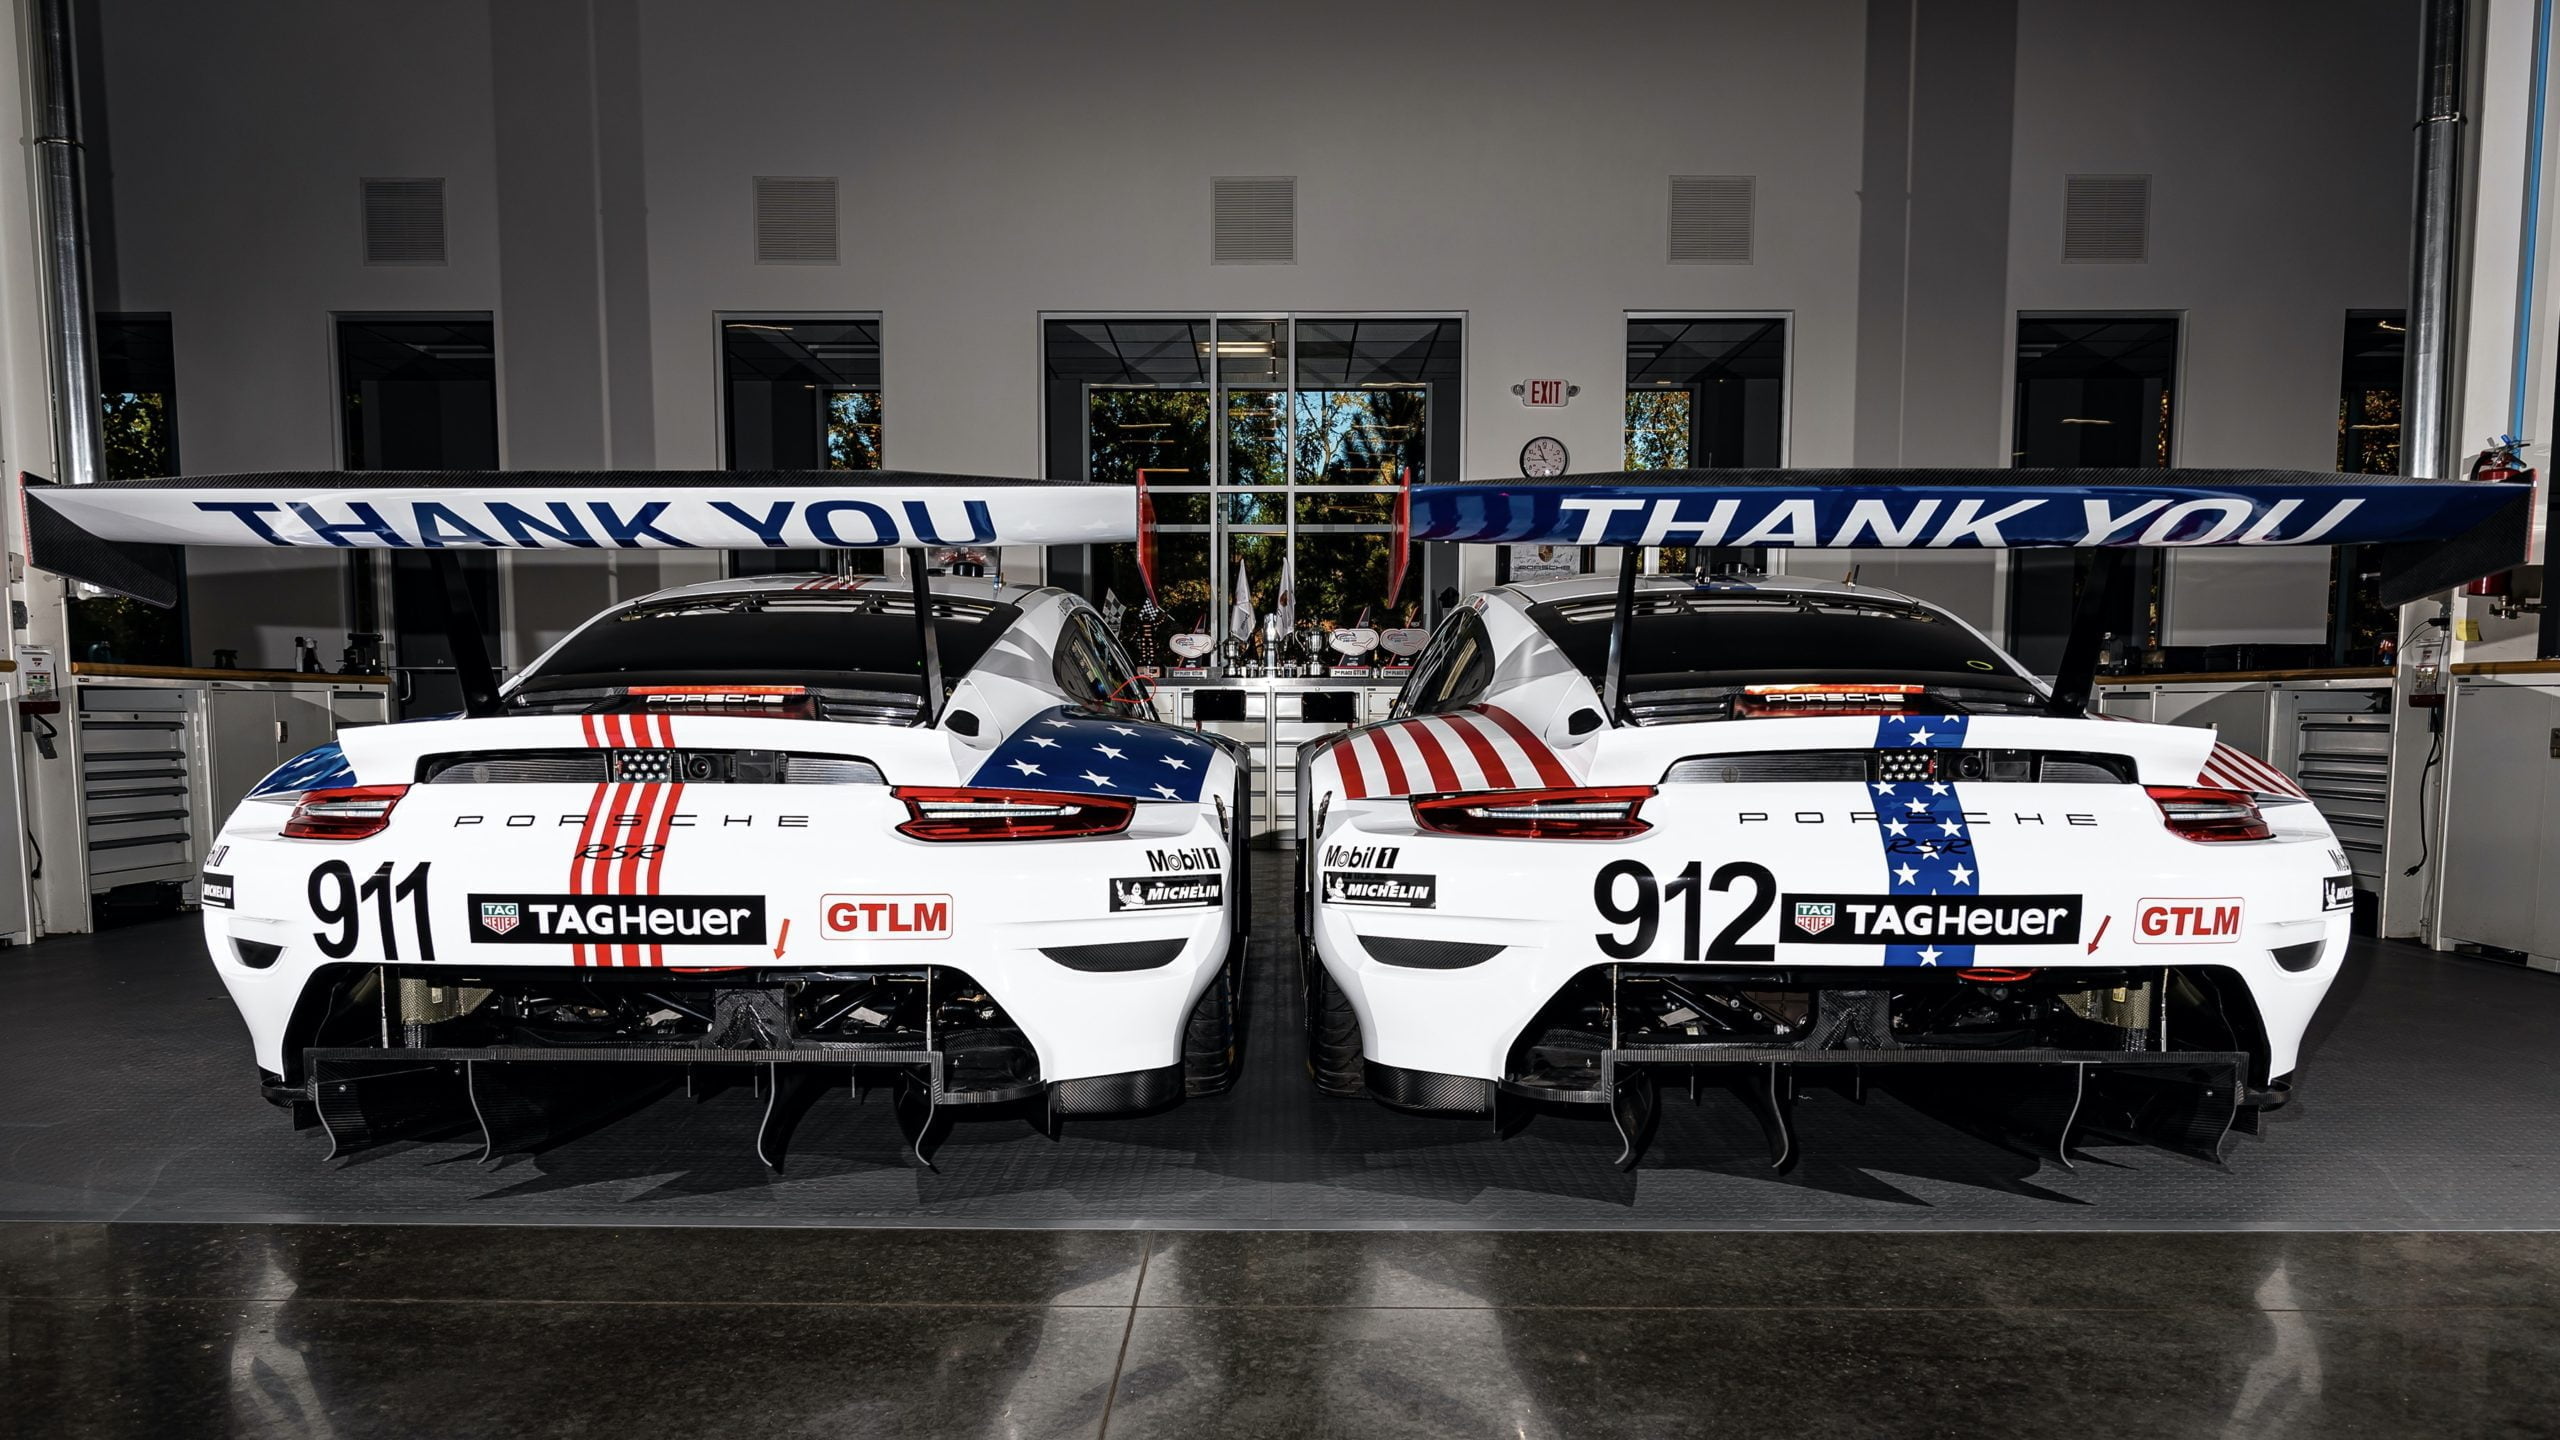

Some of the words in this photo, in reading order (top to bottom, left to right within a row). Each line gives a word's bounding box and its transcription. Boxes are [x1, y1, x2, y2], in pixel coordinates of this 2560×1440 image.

[1531, 381, 1562, 404] EXIT
[192, 501, 704, 548] THANK
[706, 500, 997, 547] YOU
[1559, 499, 2048, 548] THANK
[2074, 498, 2366, 547] YOU
[646, 694, 785, 703] PORSCHE
[1765, 693, 1905, 703] PORSCHE
[454, 814, 809, 828] PORSCHE
[1739, 811, 2098, 826] PORSCHE
[574, 843, 667, 860] RSR
[1886, 838, 1973, 855] RSR
[1145, 848, 1205, 872] Mobil
[1205, 848, 1218, 868] 1
[1324, 845, 1377, 868] Mobil
[1147, 884, 1219, 901] MICHELIN
[1347, 883, 1430, 899] MICHELIN
[307, 859, 436, 961] 911
[485, 905, 515, 915] TAG
[827, 902, 947, 932] GTLM
[1593, 859, 1777, 962] 912
[1799, 905, 1832, 915] TAG
[485, 916, 517, 932] HEUER
[1798, 916, 1833, 932] HEUER
[2141, 906, 2240, 936] GTLM
